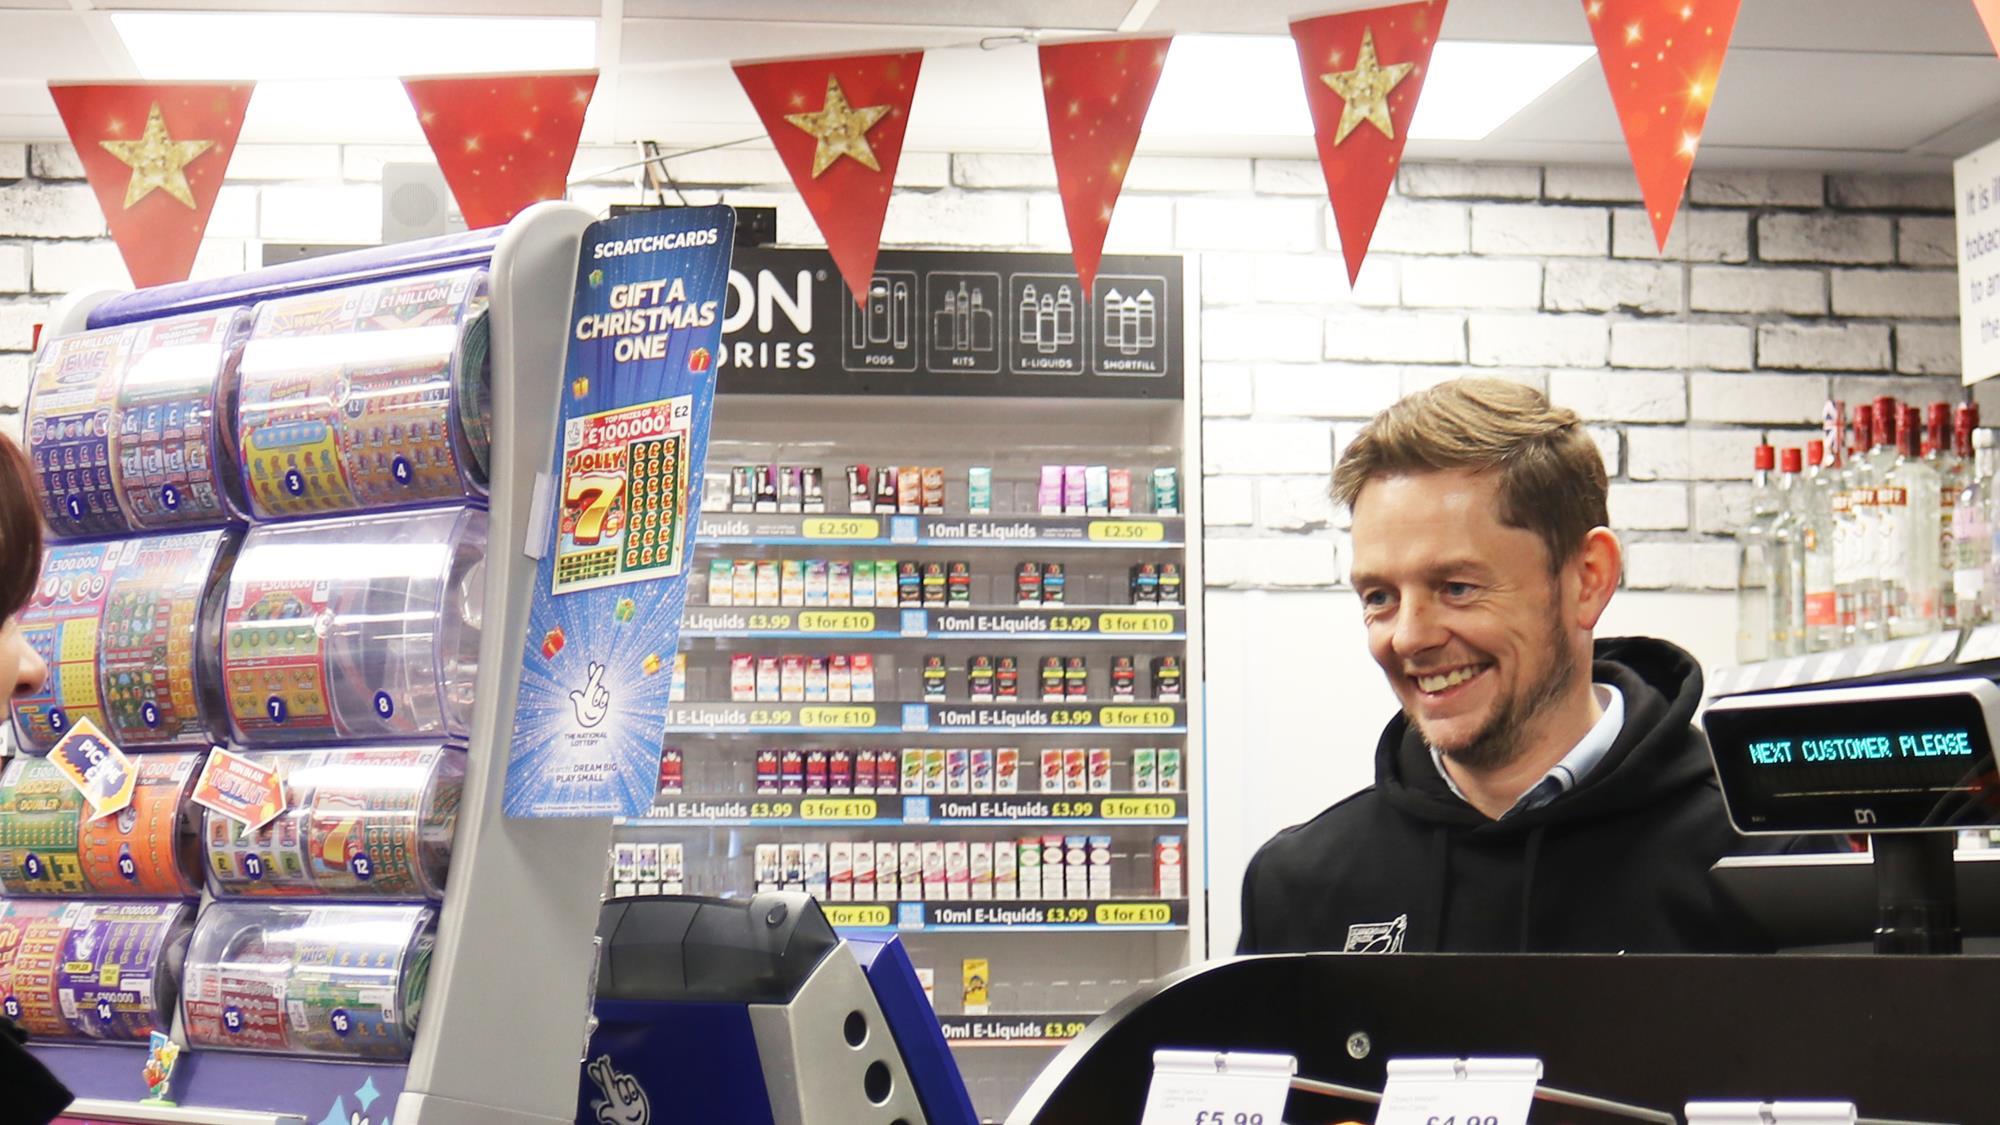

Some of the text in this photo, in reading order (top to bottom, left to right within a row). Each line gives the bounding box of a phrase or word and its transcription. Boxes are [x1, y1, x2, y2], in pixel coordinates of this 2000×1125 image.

[593, 228, 718, 259] SCRATCHCARDS
[396, 287, 449, 306] MILLION
[609, 278, 687, 309] GIFT A
[575, 300, 718, 340] CHRISTMAS
[614, 333, 668, 363] ONE
[866, 354, 894, 366] PODS
[952, 356, 975, 367] KITS
[1021, 358, 1073, 371] E-LIQUIDS
[1103, 359, 1156, 371] SHORTFILL
[674, 405, 689, 418] £2
[588, 415, 665, 445] £100,000
[571, 449, 626, 473] JOLLY
[397, 463, 407, 479] 4
[290, 475, 299, 490] 3
[165, 491, 175, 504] 2
[70, 500, 80, 515] 1
[928, 523, 964, 537] 10ml
[968, 523, 1036, 540] E-Liquids
[32, 577, 105, 600] INGO
[682, 613, 869, 631] -Liquids £3.99 3 for £10
[938, 616, 1168, 633] 10ml E-Liquids £3.99 3 for £10
[271, 702, 280, 716] 7
[379, 697, 389, 712] 8
[53, 714, 61, 728] 5
[146, 707, 155, 722] 6
[677, 710, 746, 726] E-Liquids
[750, 711, 792, 724] £3.99
[806, 712, 813, 723] 3
[818, 711, 839, 723] for
[844, 711, 870, 723] £10
[938, 711, 1169, 727] 10ml E-Liquids £3.99 3 for £10
[1749, 732, 1972, 764] NEXT CUSTOMER PLEASE
[574, 764, 602, 772] DREAM
[603, 763, 618, 772] BIG
[556, 774, 603, 783] PLAY SMALL
[678, 804, 747, 820] E-Liquids
[751, 804, 793, 817] £3.99
[806, 805, 814, 816] 3
[819, 804, 839, 816] for
[844, 804, 871, 816] £10
[939, 803, 1170, 820] 10ml E-Liquids £3.99 3 for £10
[29, 859, 37, 873] 9
[120, 860, 133, 873] 10
[247, 859, 259, 874] 11
[354, 859, 369, 874] 12
[832, 910, 884, 922] for £10
[934, 909, 1165, 925] 10ml E-Liquids £3.99 3 for £10
[5, 1002, 17, 1016] 13
[98, 1004, 112, 1019] 14
[225, 1012, 238, 1026] 15
[333, 1015, 347, 1030] 16
[941, 1023, 969, 1038] 0ml
[973, 1023, 1041, 1040] E-Liquids
[1194, 1110, 1264, 1125] £599
